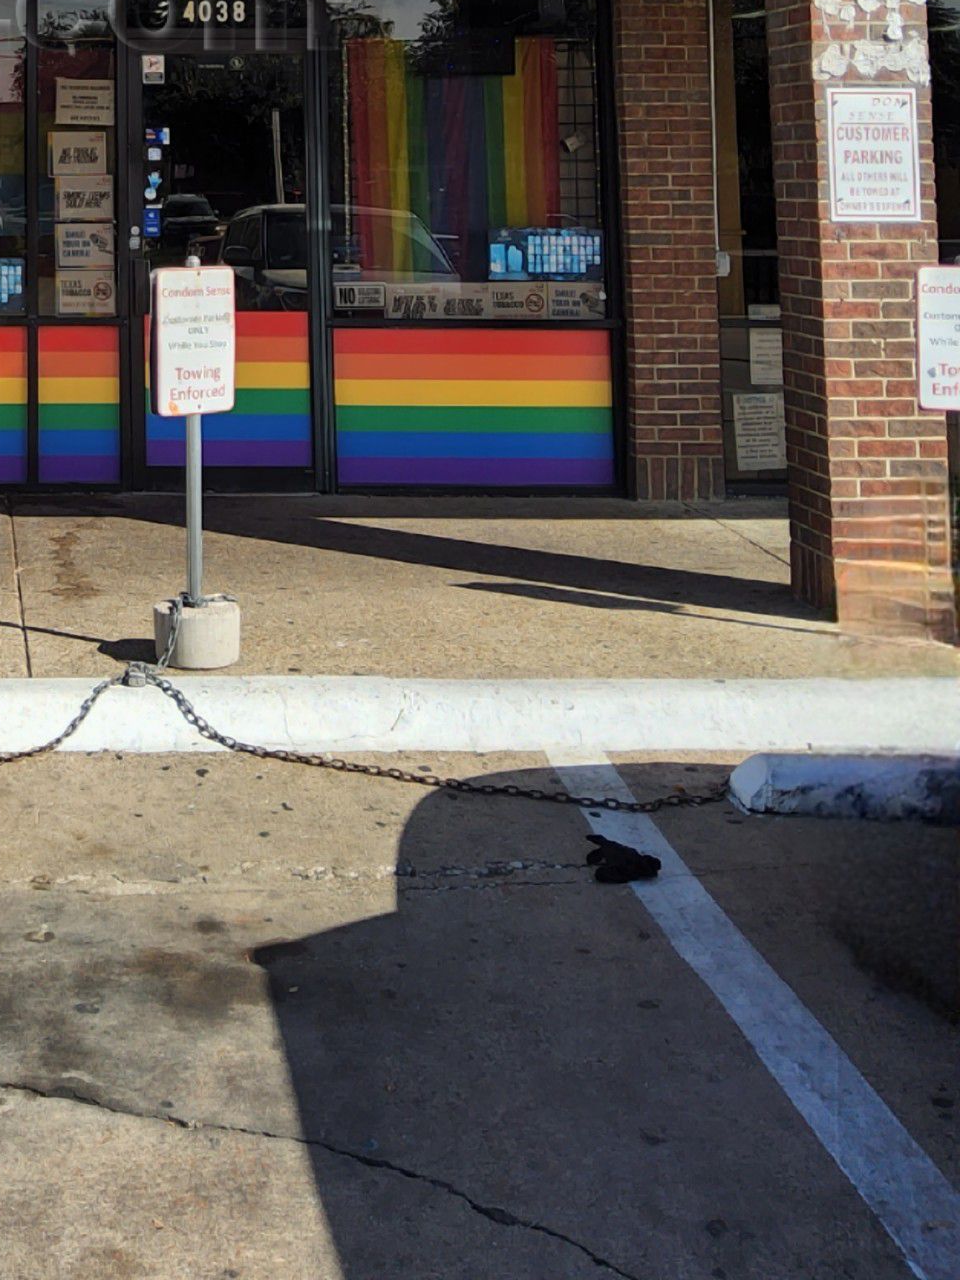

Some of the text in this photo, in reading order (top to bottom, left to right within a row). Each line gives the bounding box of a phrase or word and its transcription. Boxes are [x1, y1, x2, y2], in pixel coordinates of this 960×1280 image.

[182, 0, 246, 22] 4038
[836, 126, 910, 141] CUSTOMER
[843, 149, 903, 164] PARKING
[841, 172, 908, 182] ALL OTHERS WILL
[862, 187, 889, 196] TOWED
[161, 285, 231, 298] Condom Sense
[339, 287, 356, 304] NO
[187, 326, 208, 335] ONLY
[168, 341, 192, 350] While
[175, 366, 221, 382] Towing
[169, 384, 226, 401] Enforced
